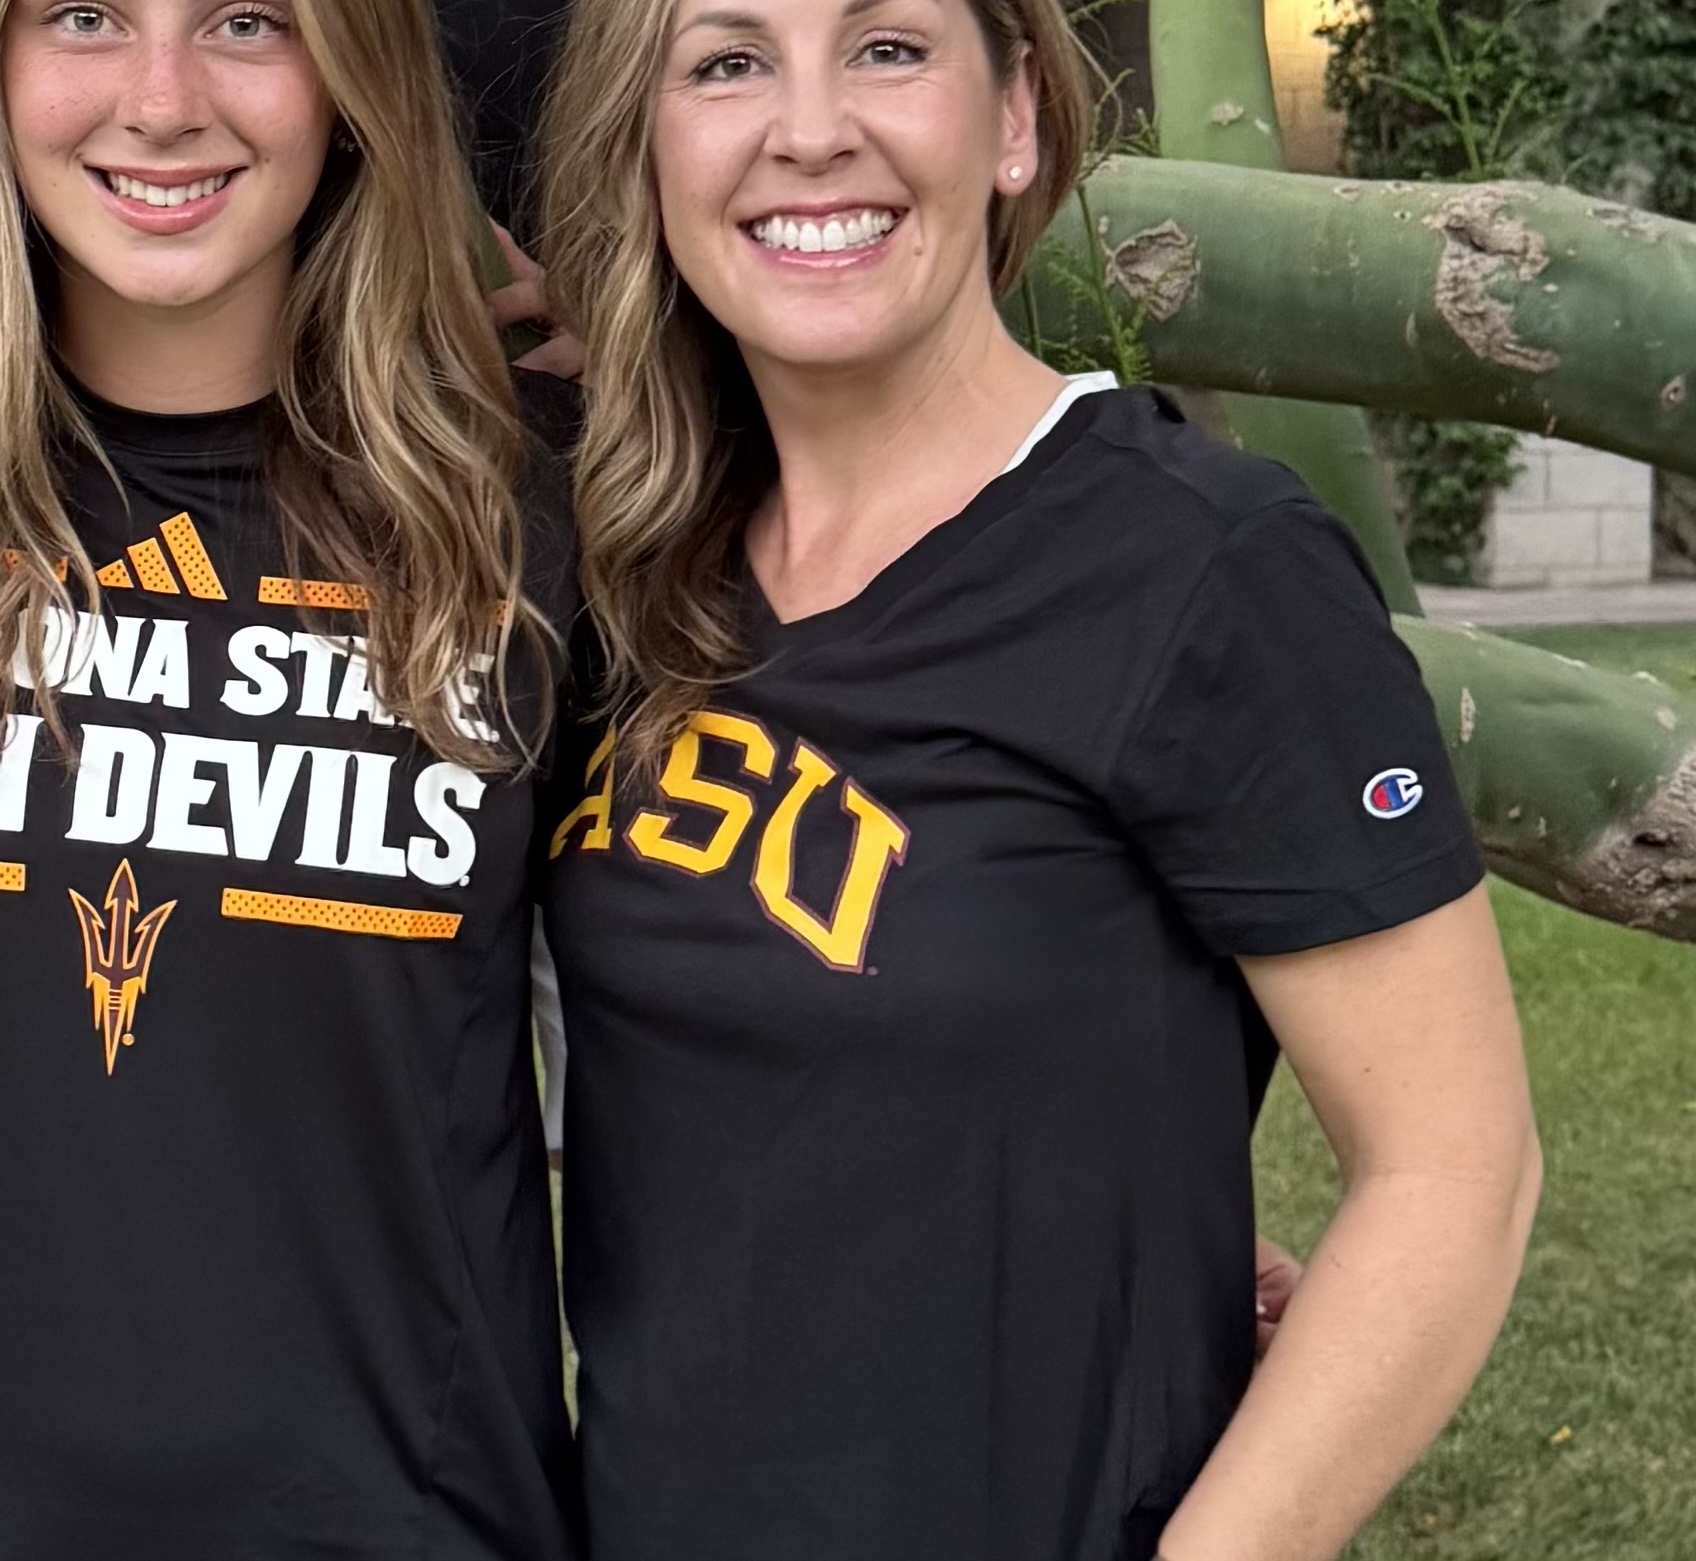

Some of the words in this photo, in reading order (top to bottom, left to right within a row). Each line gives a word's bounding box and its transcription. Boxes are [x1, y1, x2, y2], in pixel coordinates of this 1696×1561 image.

[219, 625, 496, 743] STAE
[65, 723, 487, 886] DEVILS
[549, 707, 912, 974] ASU
